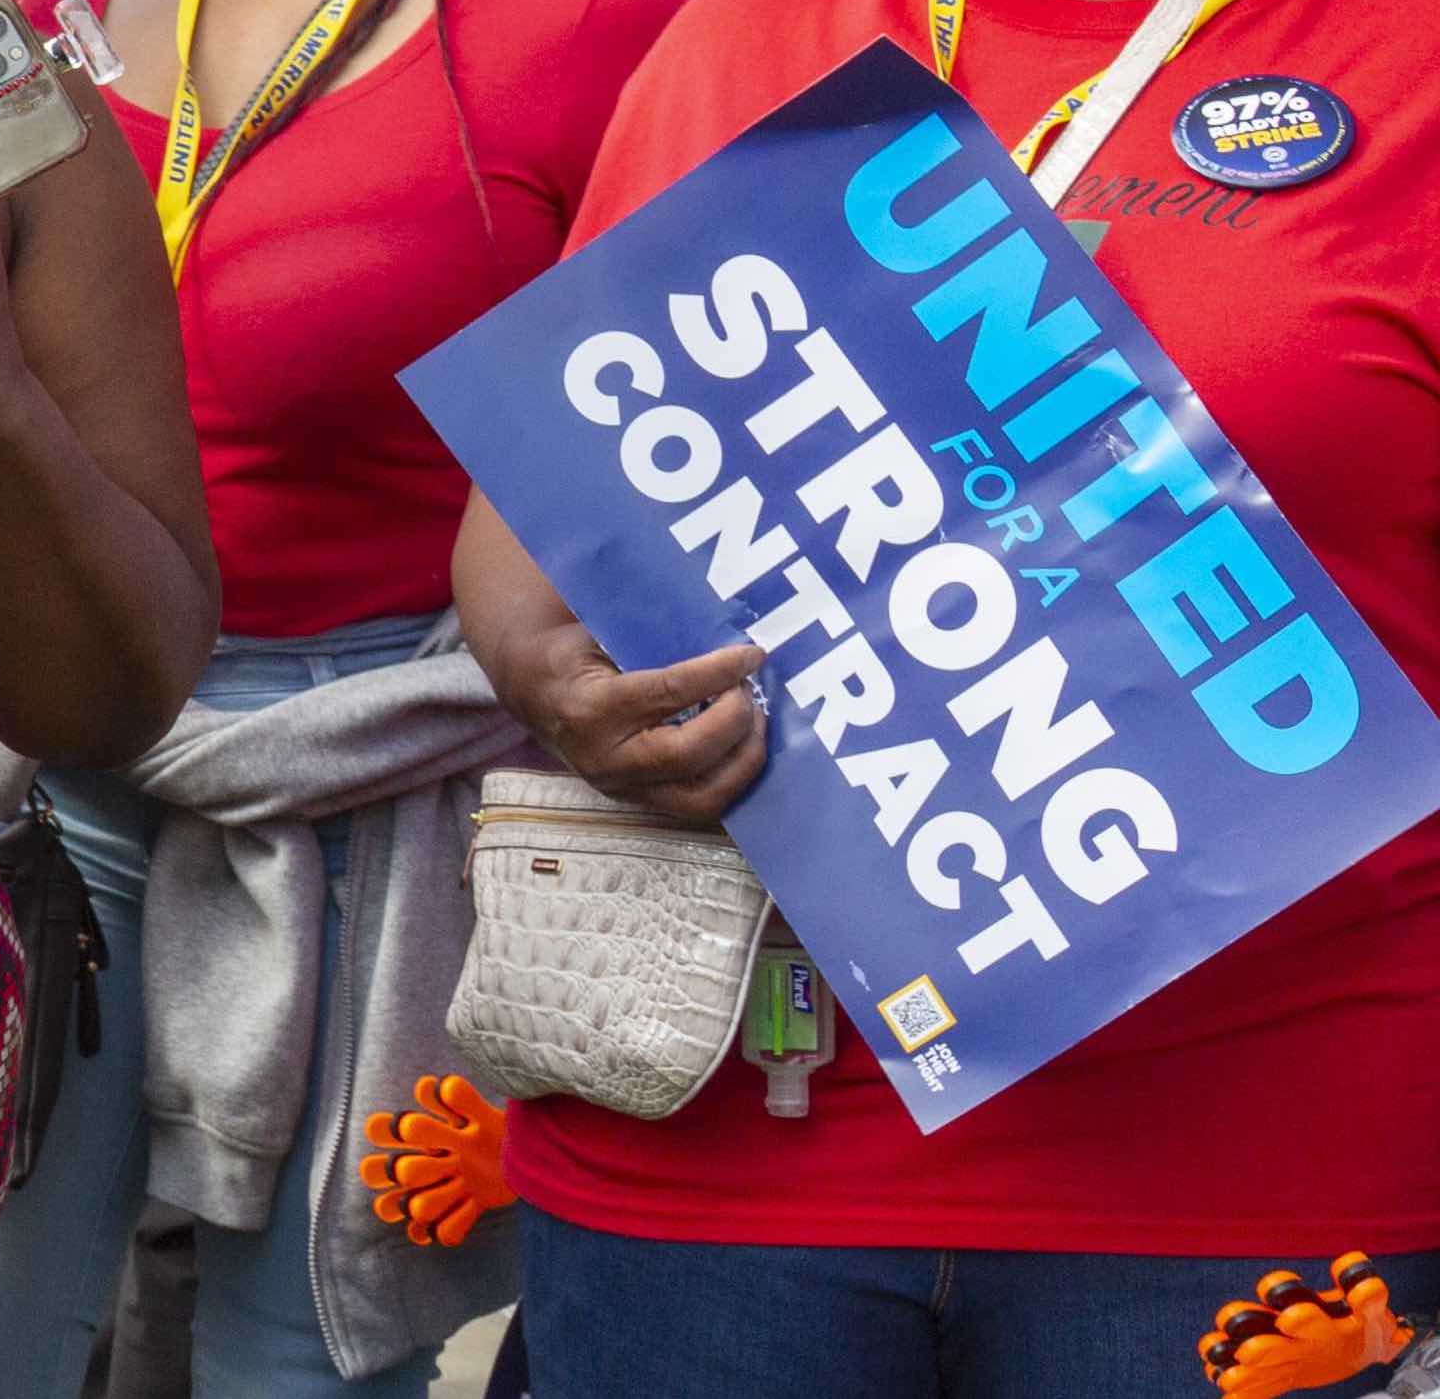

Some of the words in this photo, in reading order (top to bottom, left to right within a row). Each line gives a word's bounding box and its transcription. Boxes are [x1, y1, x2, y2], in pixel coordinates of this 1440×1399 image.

[250, 26, 330, 130] AMERICAN
[1200, 86, 1311, 126] 97%
[169, 101, 196, 183] UNITED
[1207, 114, 1282, 140] READY
[1283, 110, 1317, 126] TO
[1214, 121, 1323, 154] STRIKE
[844, 115, 1359, 775] UNITED
[929, 428, 1045, 553] FOR
[1018, 567, 1081, 609] A
[669, 255, 1178, 905] STRONG
[562, 330, 1070, 975] CONTRACT
[911, 1053, 945, 1093] FIGHT
[924, 1046, 948, 1077] THE
[933, 1042, 962, 1075] JOIN
